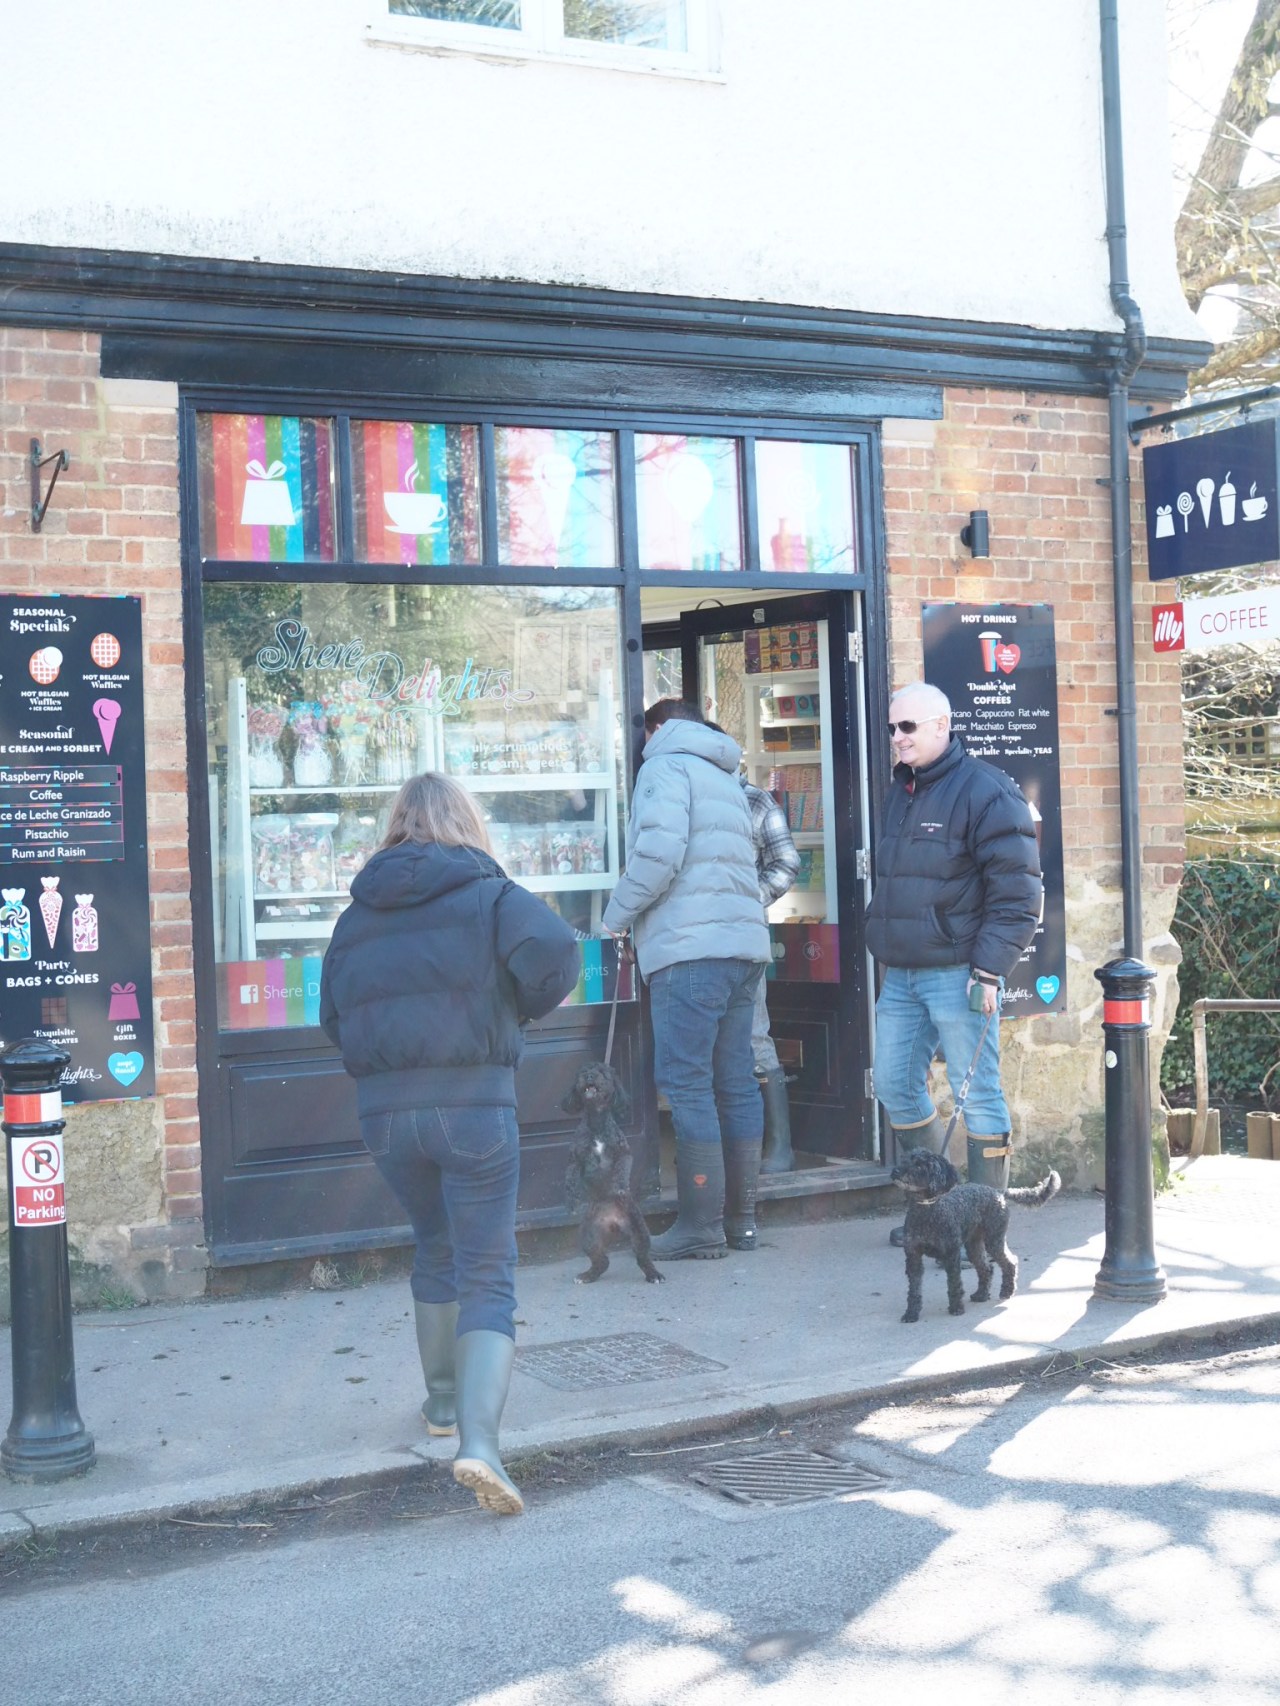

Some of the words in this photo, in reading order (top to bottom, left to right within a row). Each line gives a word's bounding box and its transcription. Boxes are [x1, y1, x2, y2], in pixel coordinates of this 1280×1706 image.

[13, 608, 66, 617] SEASONAL
[961, 614, 981, 623] HOT
[983, 615, 1017, 624] DRINKS
[10, 615, 77, 634] Specials
[1200, 606, 1268, 635] COFFEE
[1154, 611, 1183, 648] illy
[256, 618, 365, 672] Shere
[91, 680, 122, 689] Waffles
[357, 651, 535, 721] Delights
[967, 680, 1000, 692] Double
[998, 682, 1016, 696] shot
[29, 696, 61, 706] Waffles
[973, 696, 1011, 705] COFFEES
[975, 709, 1015, 719] Cappuccino
[1018, 708, 1030, 717] Flat
[1032, 708, 1050, 717] white
[19, 725, 75, 740] Seasonal
[970, 722, 1005, 731] Macchiato
[1008, 721, 1037, 732] Espresso
[8, 745, 44, 753] CREAM
[63, 744, 102, 753] SORBET
[1034, 747, 1053, 755] TEAS
[0, 772, 51, 784] Raspberry
[53, 770, 84, 782] Ripple
[29, 790, 63, 800] Coffee
[14, 810, 27, 820] de
[29, 810, 58, 820] Leche
[60, 808, 111, 819] Granizado
[25, 829, 69, 840] Pistachio
[12, 849, 36, 858] Rum
[38, 848, 55, 858] and
[57, 847, 86, 857] Raisin
[34, 960, 77, 974] Party
[581, 963, 609, 981] ights
[6, 977, 42, 988] BAGS
[55, 973, 99, 985] CONES
[263, 985, 303, 999] Shere
[33, 1027, 76, 1039] Exquisite
[59, 1066, 102, 1085] lights
[33, 1188, 55, 1202] NO
[18, 1205, 65, 1220] Parking
